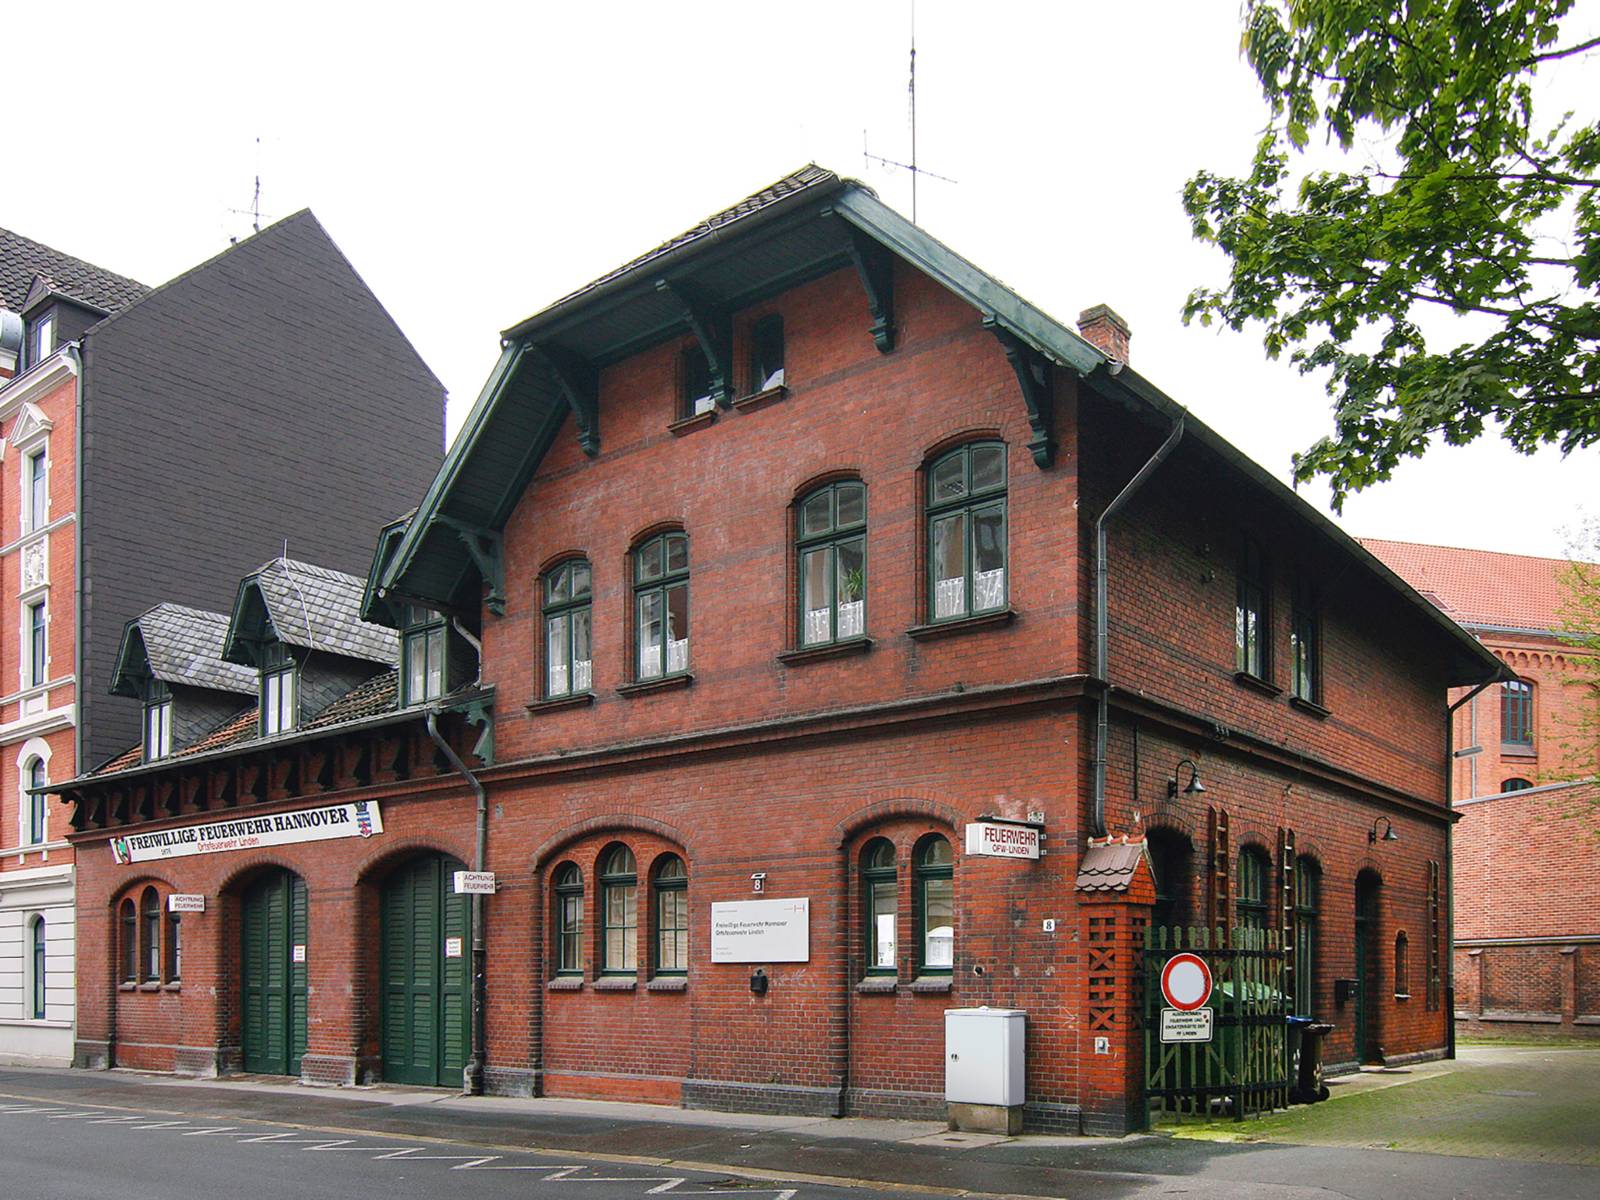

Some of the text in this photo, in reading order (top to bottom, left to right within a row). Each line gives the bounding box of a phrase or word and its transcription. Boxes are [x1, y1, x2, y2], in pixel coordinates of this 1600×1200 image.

[130, 808, 349, 850] FREIWILLIGE FEUERWEHR HANNOVER
[984, 827, 1037, 846] FEUERWEHR
[197, 837, 259, 852] Ortsfeuerwehr Linden
[992, 844, 1030, 855] OFW-LINDEN
[463, 882, 494, 890] FEUERWEHR
[754, 880, 761, 890] 8
[1046, 921, 1052, 930] 8
